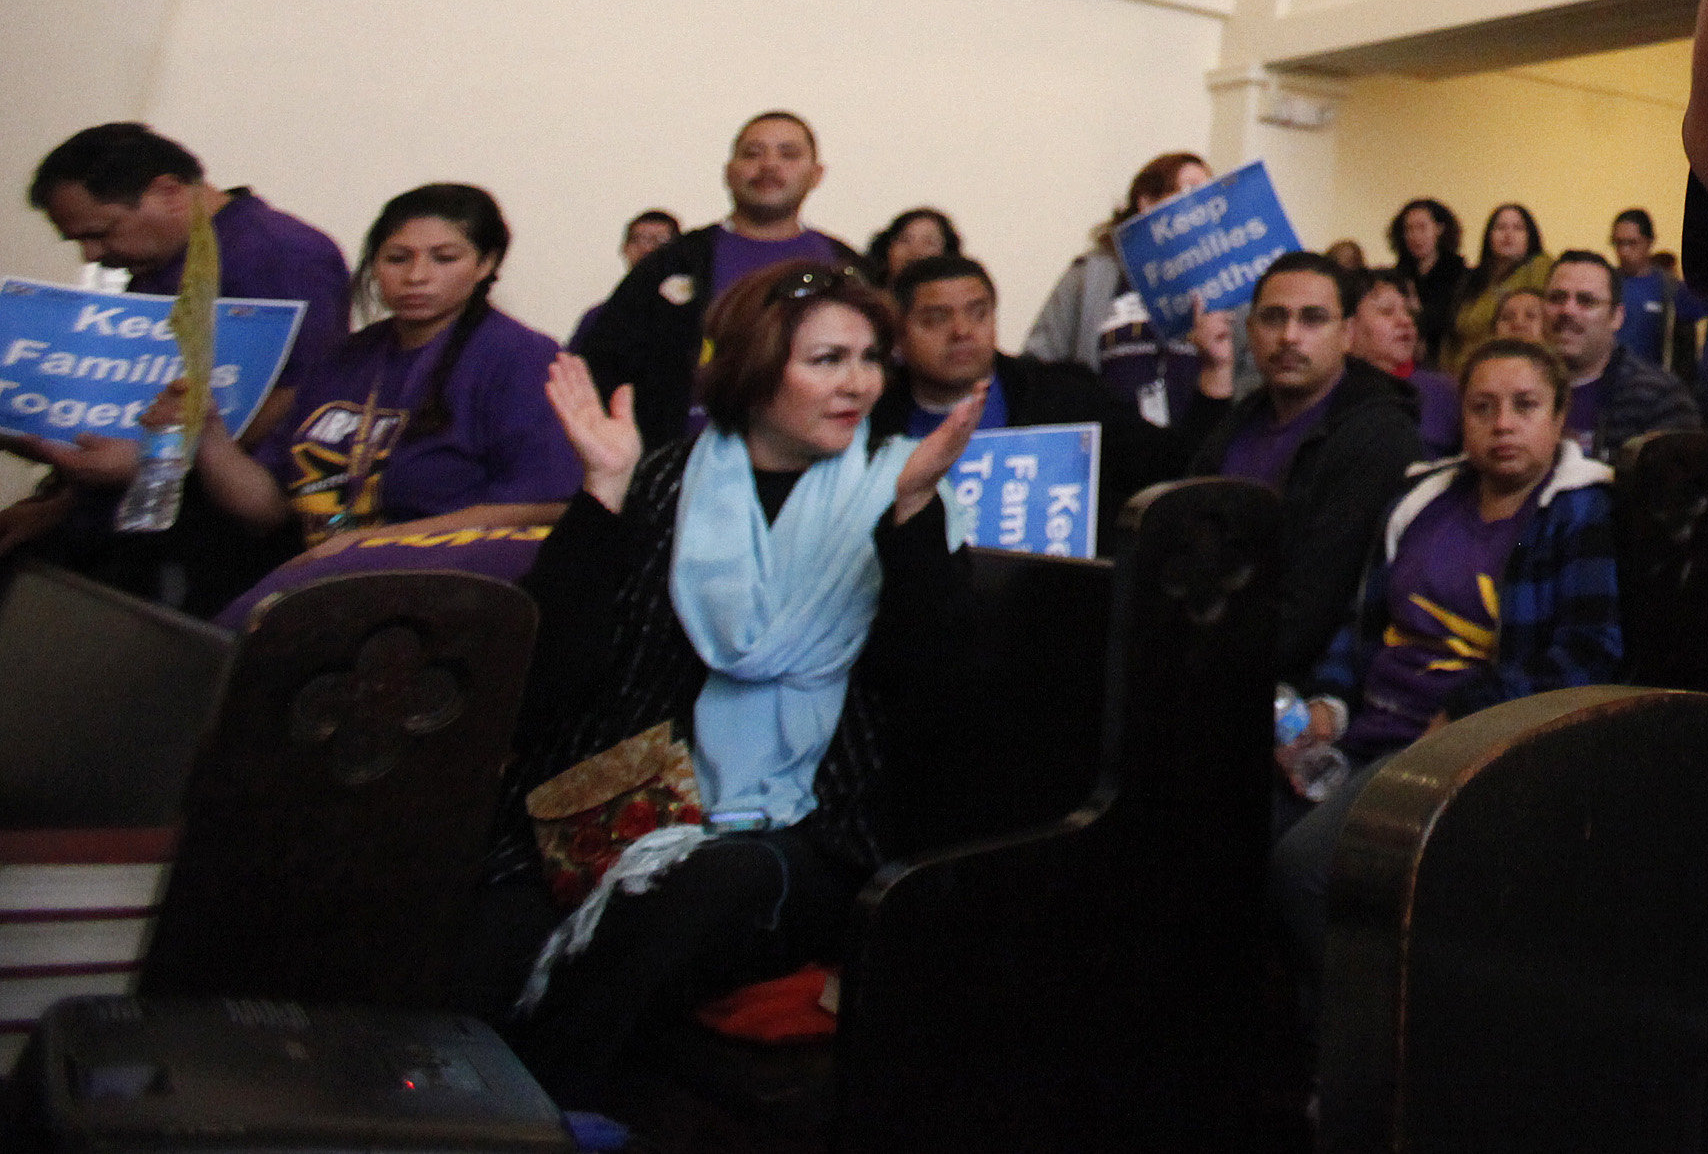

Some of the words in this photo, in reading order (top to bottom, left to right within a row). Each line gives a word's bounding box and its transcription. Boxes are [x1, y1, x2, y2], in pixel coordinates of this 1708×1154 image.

[1151, 196, 1229, 245] Keep
[1143, 218, 1268, 288] Families
[71, 303, 178, 342] Kee
[3, 338, 242, 389] Familis
[1045, 482, 1083, 557] Kee
